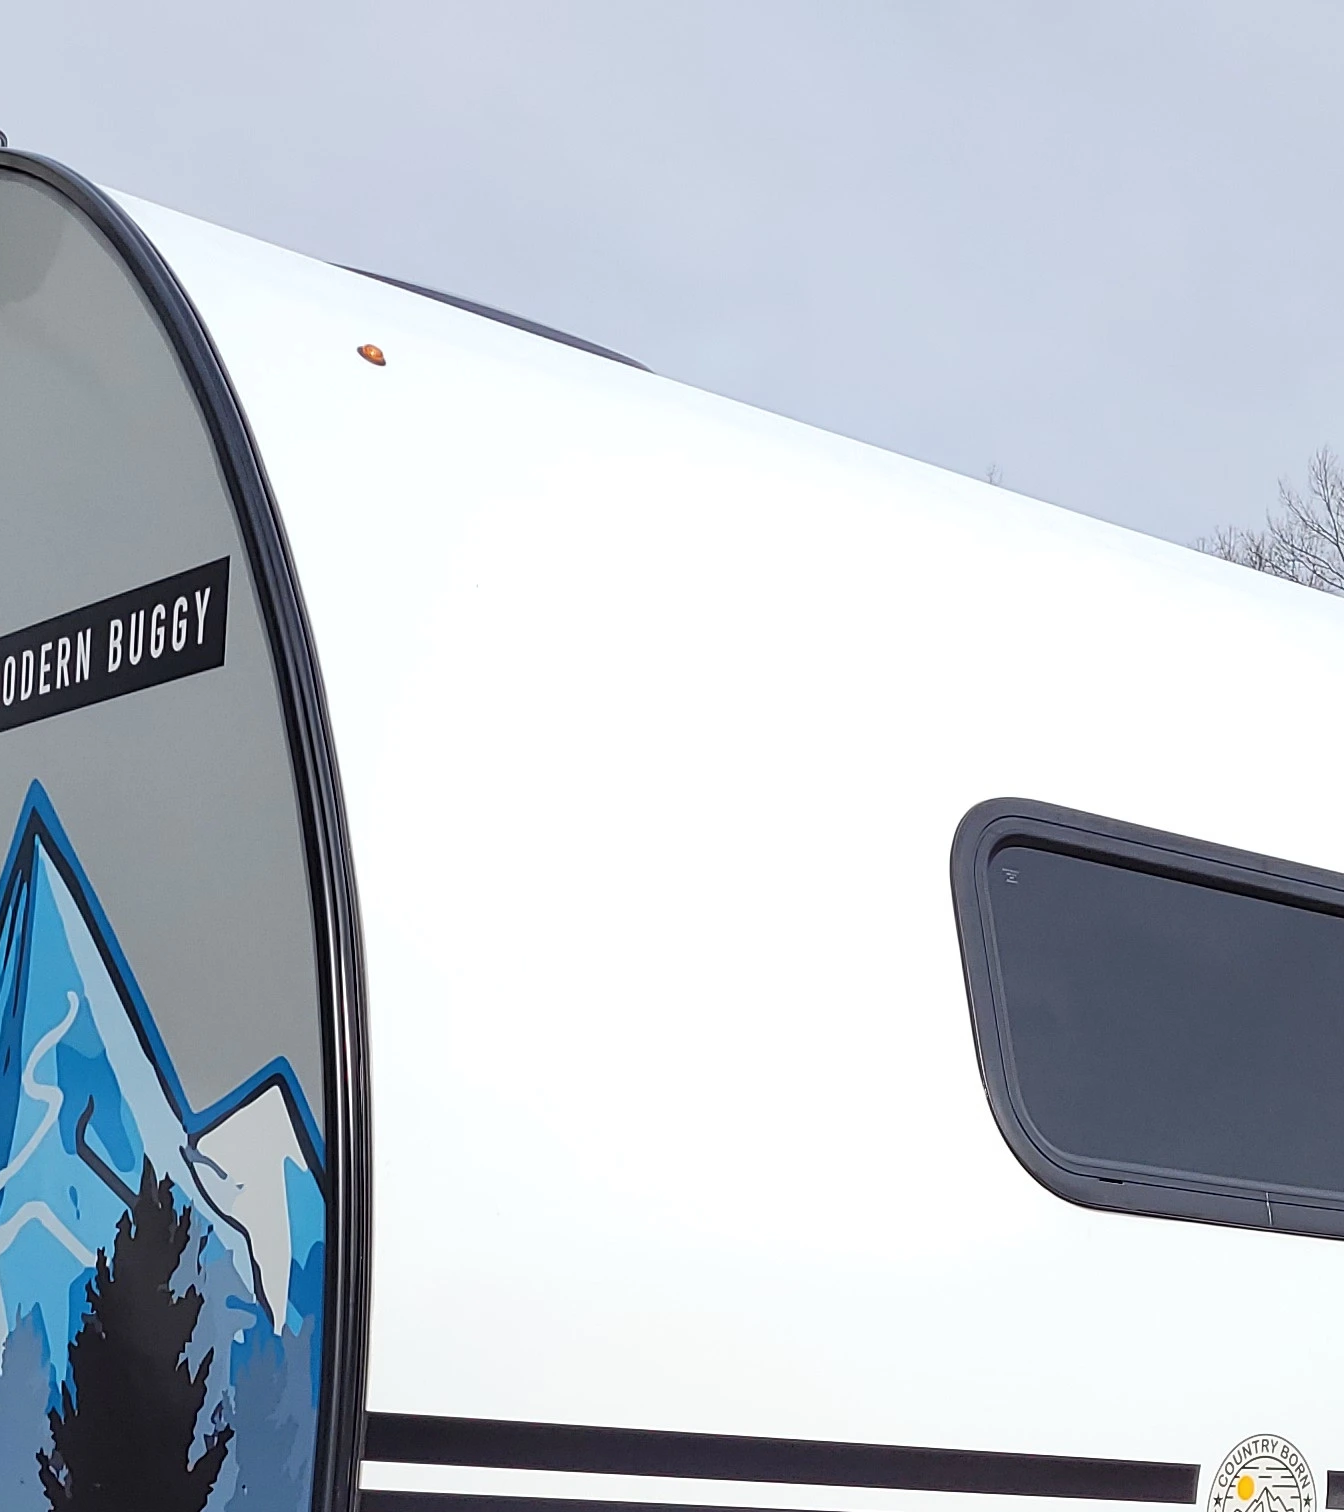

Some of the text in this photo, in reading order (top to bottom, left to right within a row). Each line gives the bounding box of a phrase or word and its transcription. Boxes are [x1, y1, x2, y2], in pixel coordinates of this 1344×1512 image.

[107, 587, 211, 672] BUGGY
[1218, 1438, 1311, 1490] COUNTRY BORN
